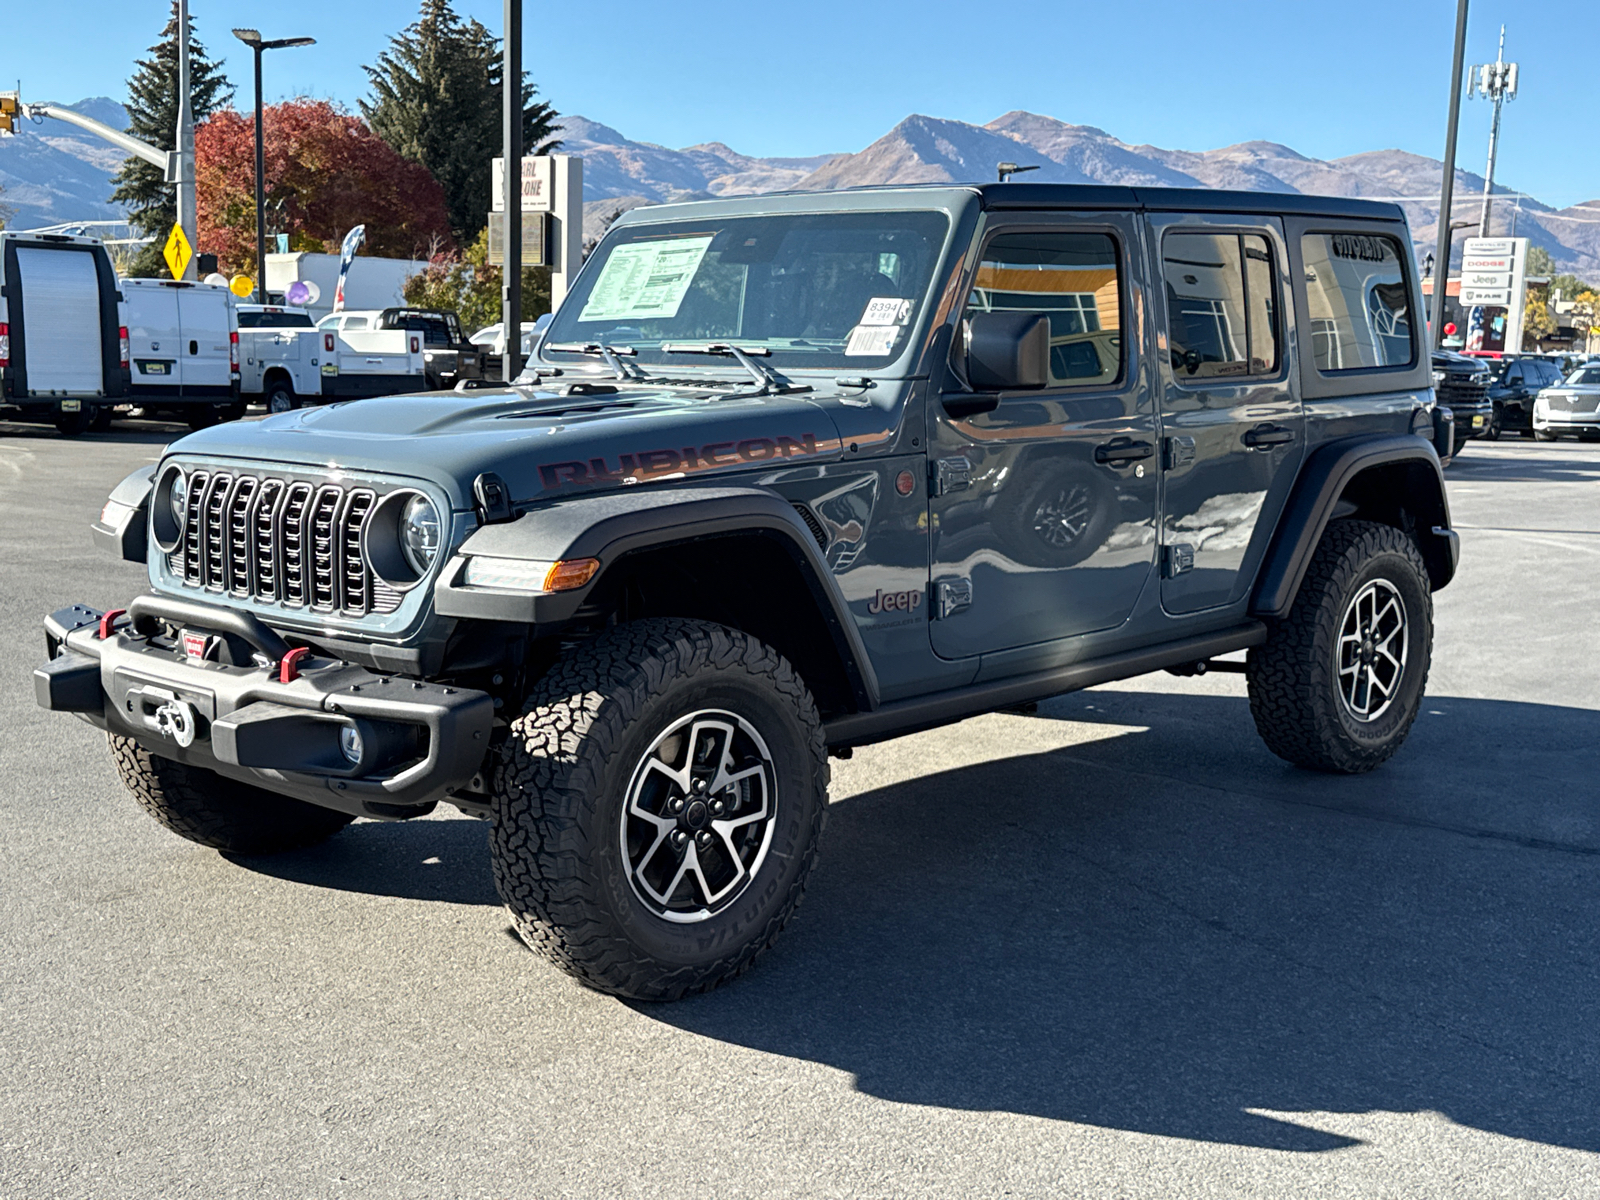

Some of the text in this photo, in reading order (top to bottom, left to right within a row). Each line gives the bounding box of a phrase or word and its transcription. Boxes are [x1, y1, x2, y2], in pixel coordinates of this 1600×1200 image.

[1472, 275, 1497, 285] Jeep
[870, 302, 898, 312] 8394
[537, 433, 817, 489] RUBICON
[867, 588, 922, 615] Jeep
